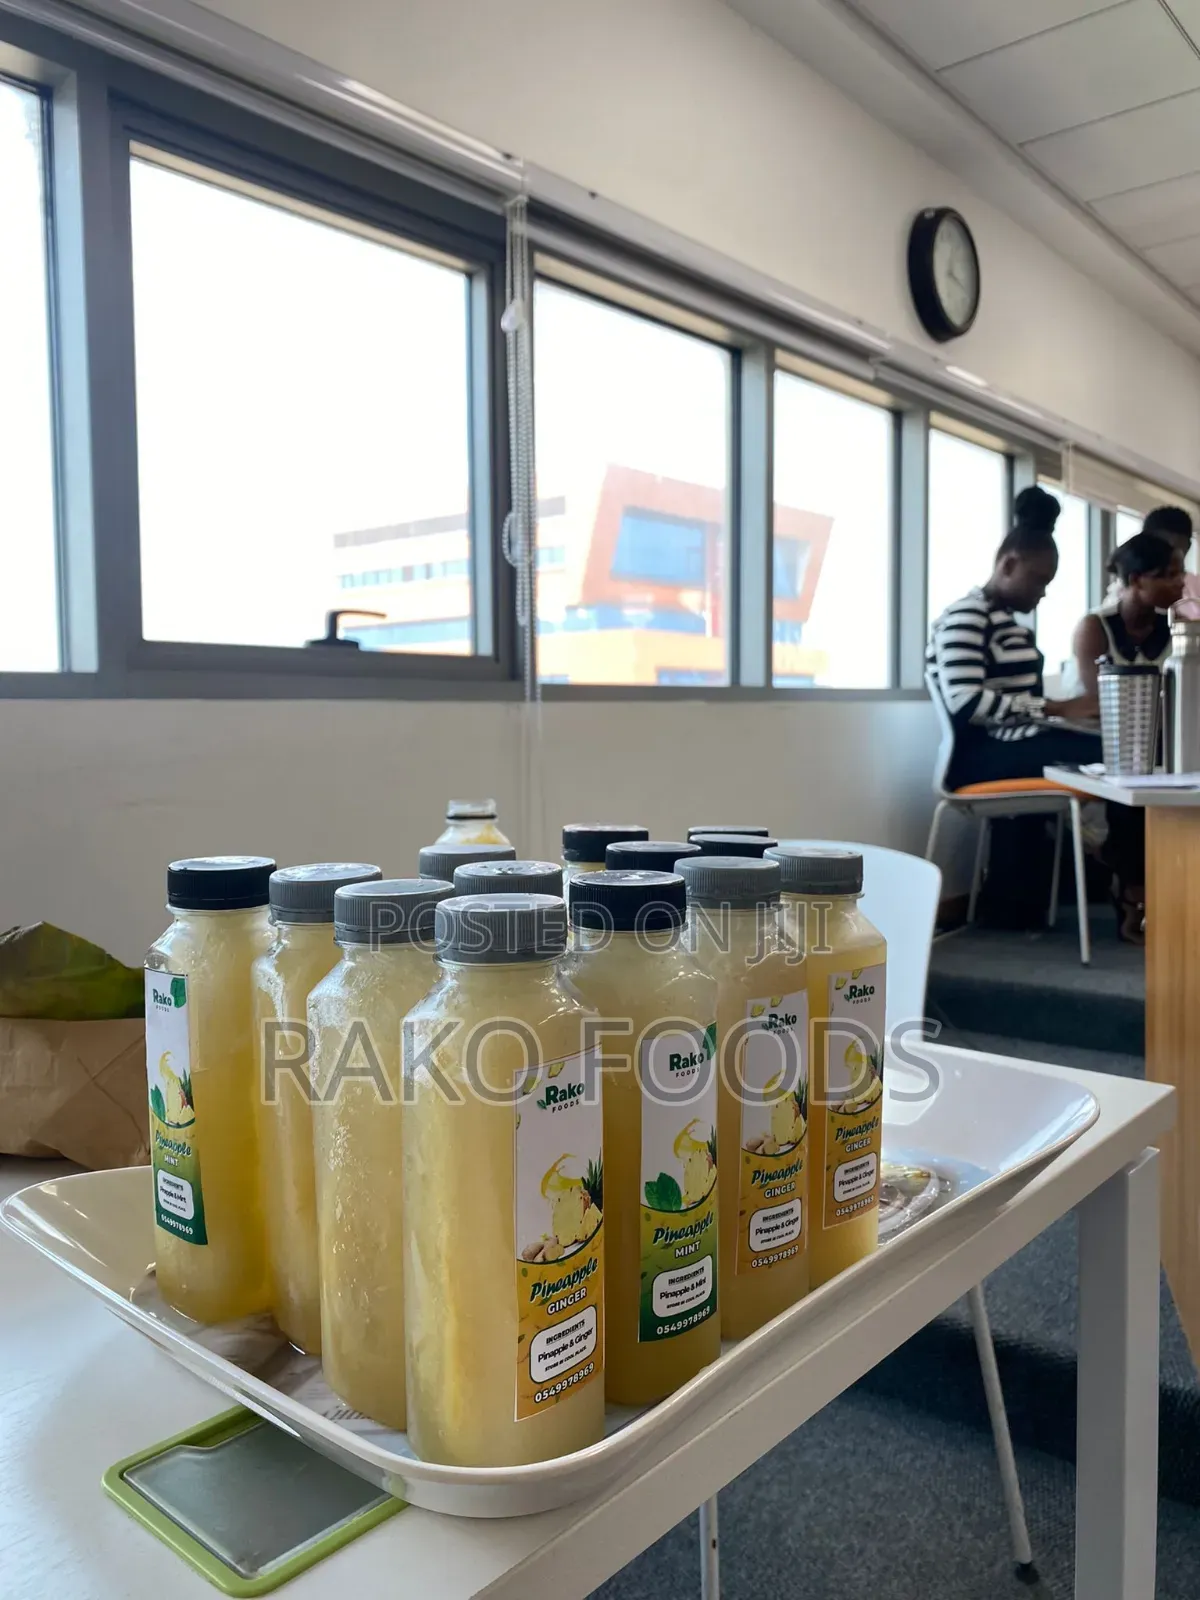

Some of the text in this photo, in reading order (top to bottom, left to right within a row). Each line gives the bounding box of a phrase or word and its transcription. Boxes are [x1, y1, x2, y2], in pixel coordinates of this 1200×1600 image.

[152, 988, 172, 1006] Rako
[849, 984, 875, 999] Rako
[768, 1013, 797, 1029] Rako
[669, 1052, 704, 1071] Rako
[675, 1067, 700, 1078] FOODS
[545, 1083, 585, 1106] Rako
[552, 1098, 580, 1113] FOODS
[845, 1138, 871, 1153] GINGER
[164, 1154, 178, 1166] MINT
[764, 1181, 796, 1198] GINGER
[675, 1241, 701, 1258] MINT
[751, 1245, 799, 1268] 0549978969
[530, 1256, 598, 1303] Pineapple
[668, 1266, 704, 1285] INGREDIENTS
[546, 1286, 587, 1315] GINGER
[660, 1286, 690, 1299] Pinapple
[657, 1305, 710, 1335] 0549978969
[546, 1319, 585, 1345] INGREDIENTS
[538, 1327, 593, 1363] Pinapple & Ginger
[534, 1362, 594, 1403] 0549978969
